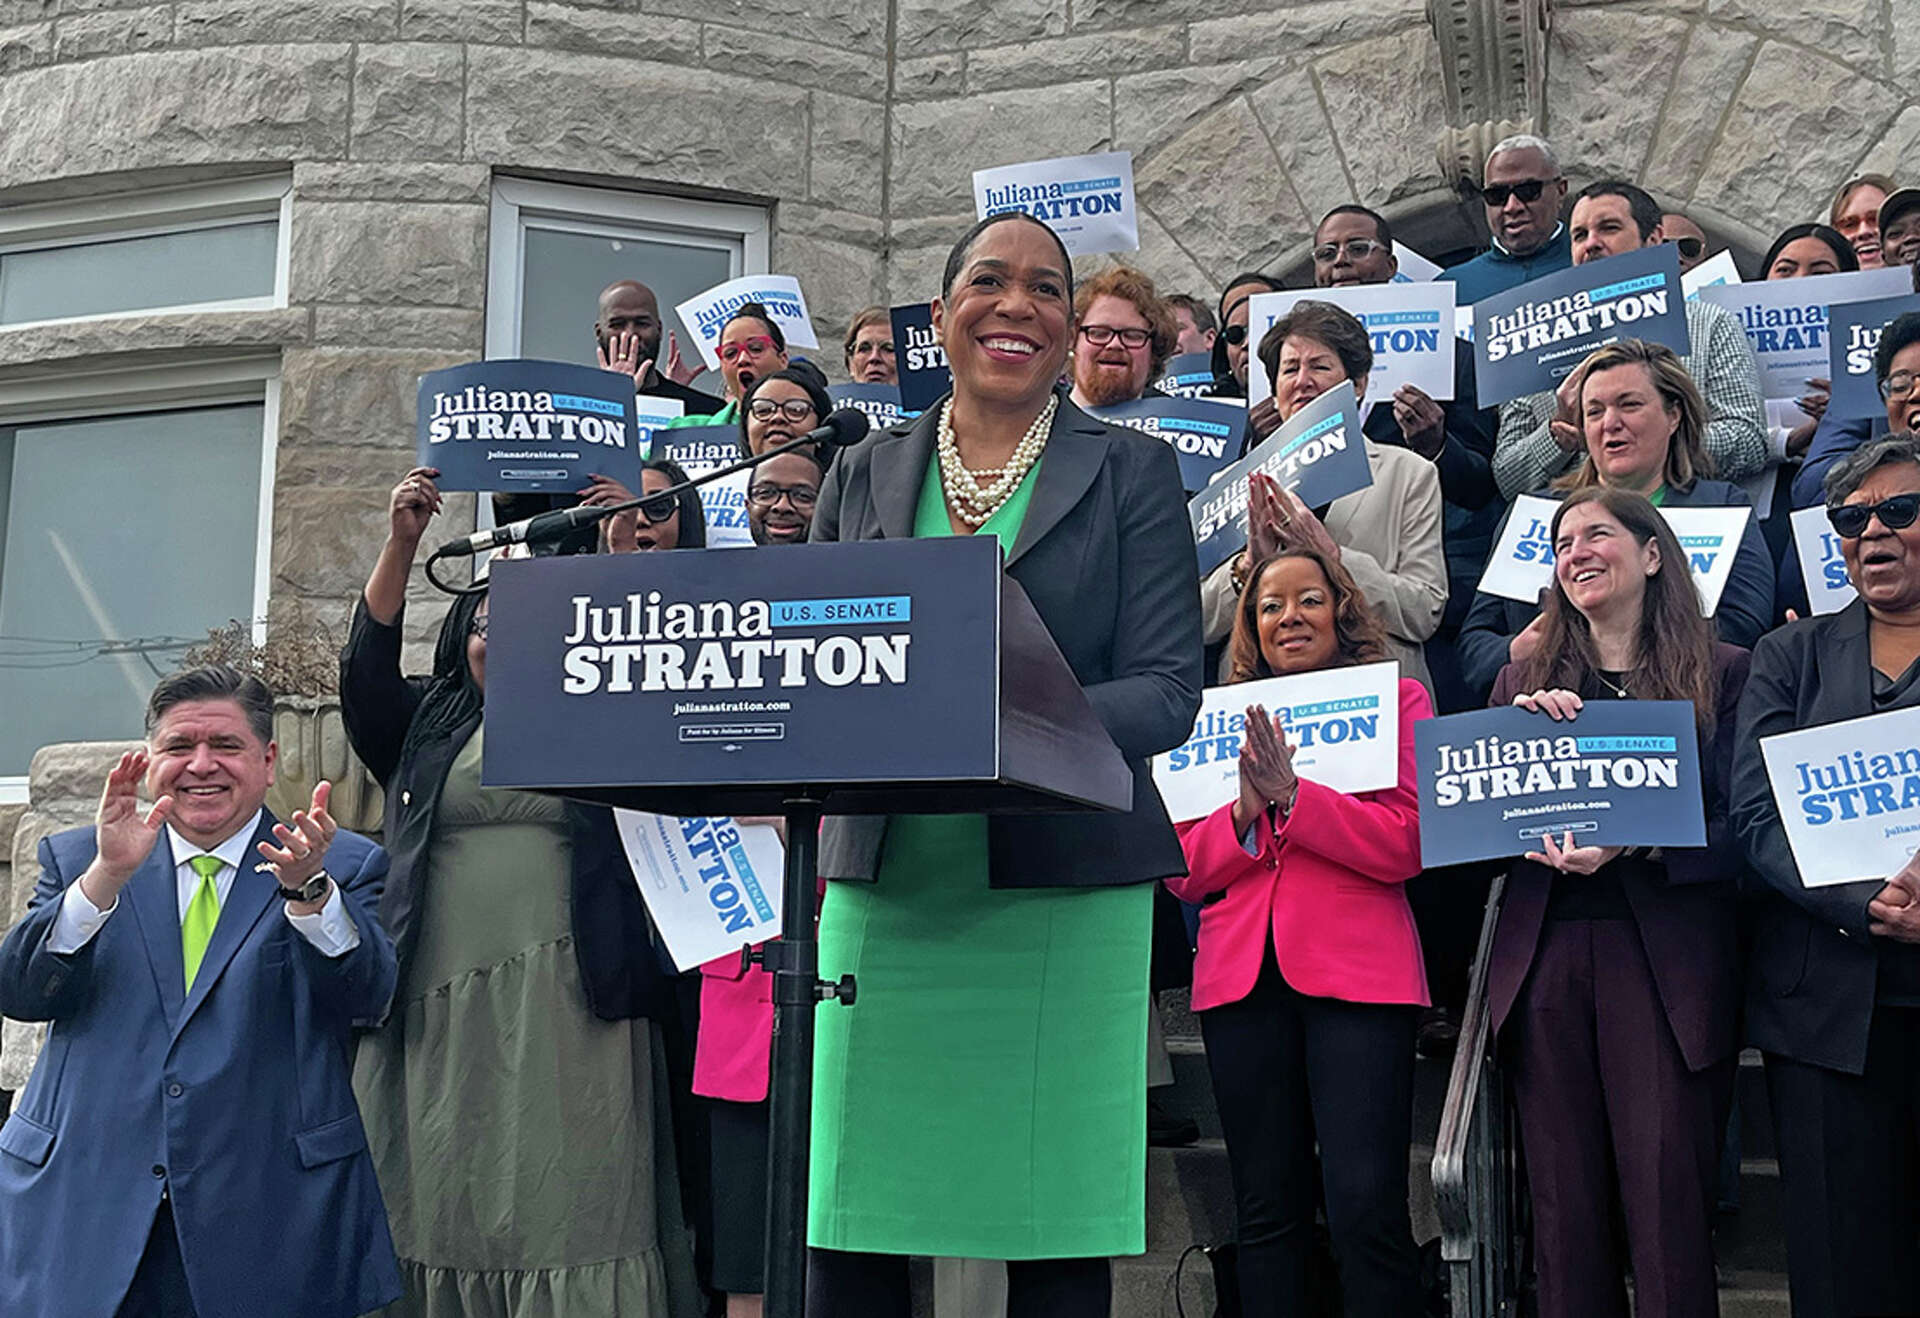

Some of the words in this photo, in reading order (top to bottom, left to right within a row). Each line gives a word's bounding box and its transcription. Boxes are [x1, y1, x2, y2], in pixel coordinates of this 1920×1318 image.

[985, 183, 1063, 209] Juliana
[694, 290, 765, 328] Juliana
[1487, 290, 1593, 340] Juliana
[1487, 290, 1668, 362] STRATTON
[1736, 304, 1824, 329] liana
[430, 385, 555, 419] Juliana
[429, 412, 626, 448] STRATTON
[664, 441, 742, 461] Julian
[565, 591, 773, 644] Juliana
[781, 607, 816, 621] U.S.
[824, 602, 898, 620] SENATE
[563, 634, 911, 695] STRATTON
[672, 701, 791, 716] julianastratton.com
[1325, 698, 1372, 713] SENATE
[1435, 736, 1580, 777] Juliana
[1615, 739, 1668, 749] SENATE
[1796, 747, 1920, 795] Julian
[1435, 758, 1679, 807] STRATTON
[1801, 775, 1920, 826] STRA
[1502, 800, 1612, 821] julianastratton.com
[679, 816, 754, 935] ATTON
